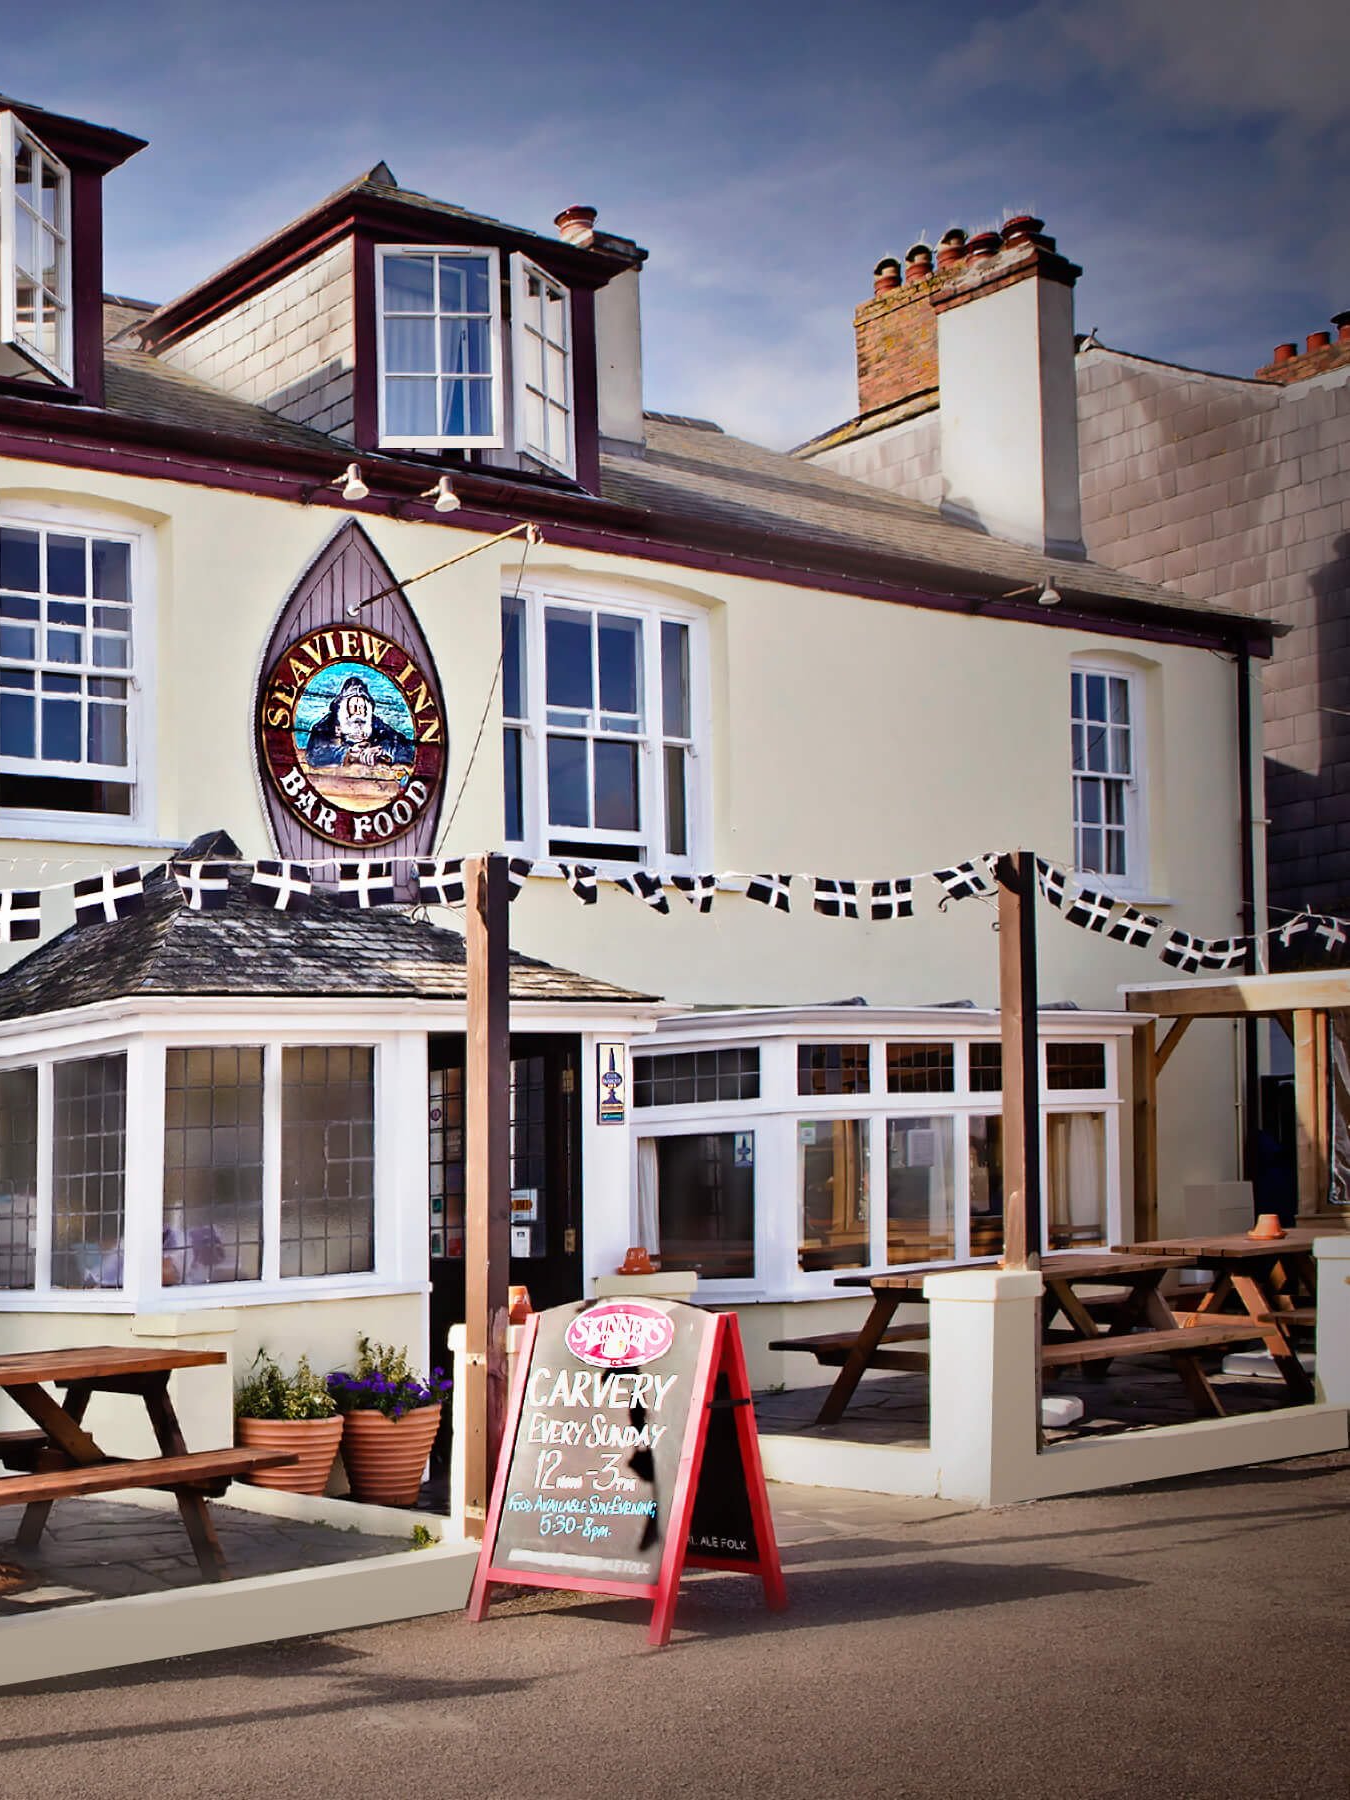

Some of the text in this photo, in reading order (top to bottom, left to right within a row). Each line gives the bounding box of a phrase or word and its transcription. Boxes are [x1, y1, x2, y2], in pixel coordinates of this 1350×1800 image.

[267, 630, 441, 745] SEAVIEW INN
[279, 766, 428, 841] BAR FOOD
[528, 1367, 679, 1411] CARVERY
[528, 1412, 667, 1449] EVERY SUNDAY
[534, 1494, 588, 1514] AVAILABLE
[700, 1536, 719, 1548] ALE
[721, 1538, 747, 1550] FOLK
